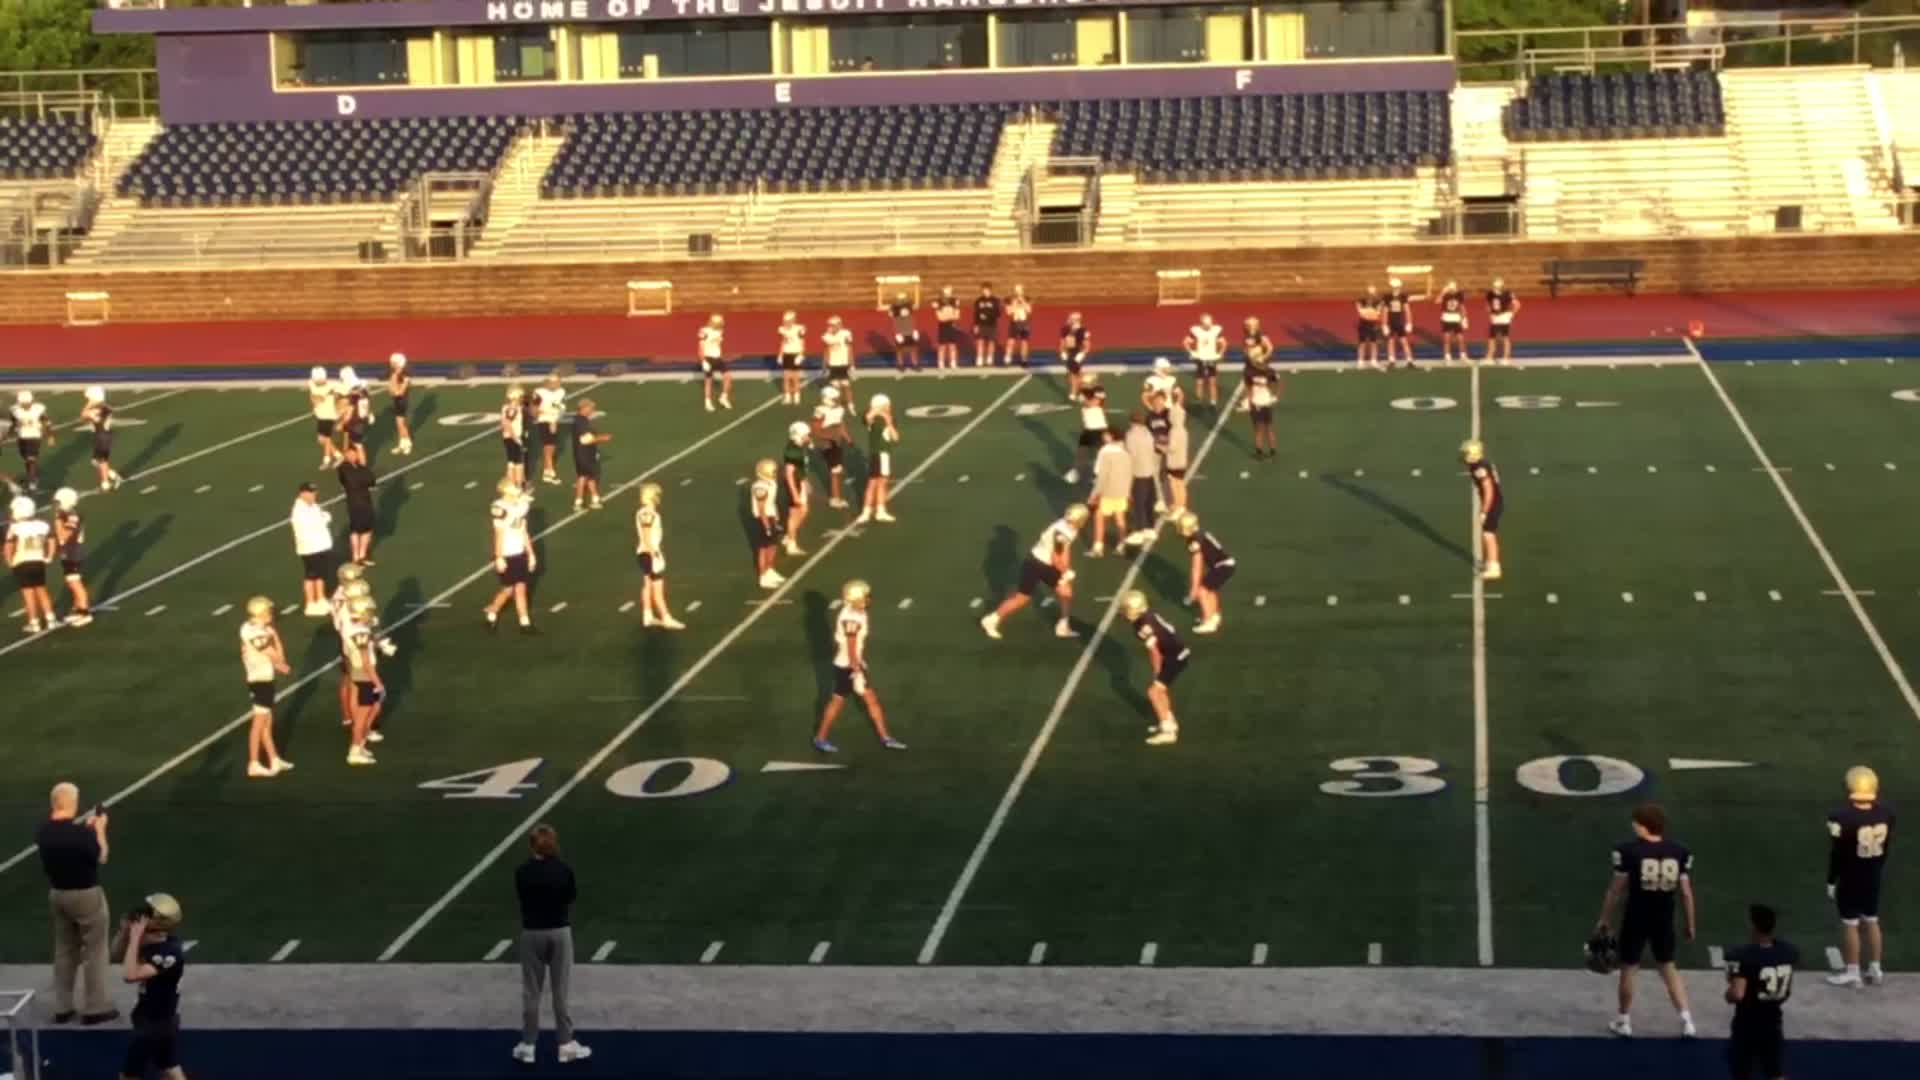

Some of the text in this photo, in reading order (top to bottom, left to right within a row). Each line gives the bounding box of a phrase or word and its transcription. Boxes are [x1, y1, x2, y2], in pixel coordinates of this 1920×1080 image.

[487, 1, 589, 20] HOME
[607, 0, 650, 17] OF
[1236, 70, 1252, 90] F
[775, 82, 791, 102] E
[337, 94, 356, 115] D
[1758, 964, 1792, 1000] 37
